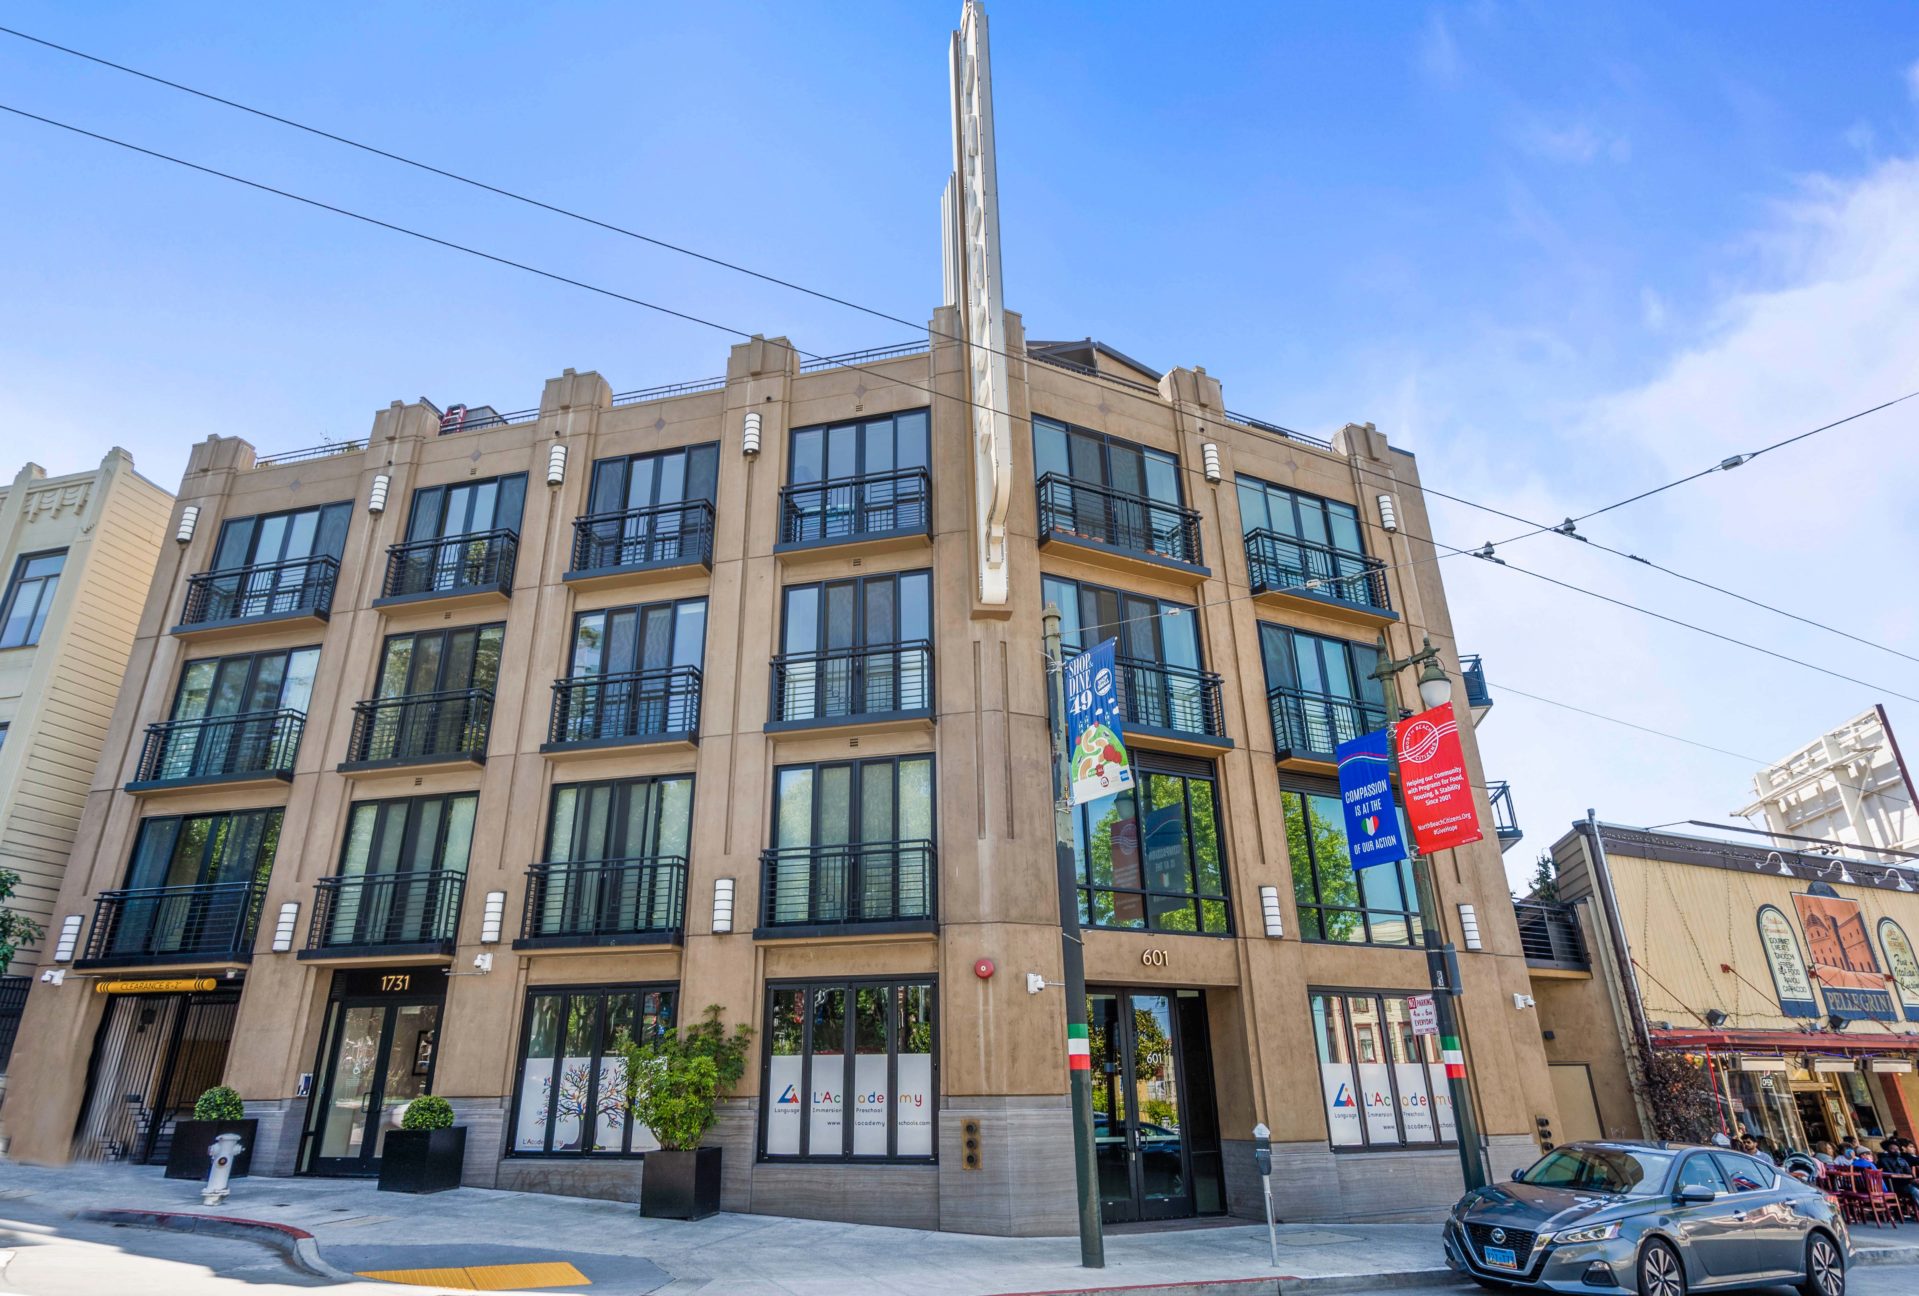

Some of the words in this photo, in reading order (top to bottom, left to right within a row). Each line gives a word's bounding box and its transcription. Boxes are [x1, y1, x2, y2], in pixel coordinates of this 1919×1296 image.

[1069, 653, 1090, 677] SHOP
[1069, 670, 1091, 697] DINE
[1069, 690, 1092, 714] 49
[1415, 724, 1433, 733] BEACH
[1406, 778, 1425, 787] Helping
[1433, 767, 1462, 779] Community
[1344, 779, 1388, 804] COMPASSION
[1407, 787, 1418, 795] with
[1418, 781, 1441, 792] Programs
[1439, 783, 1461, 794] Stability
[1354, 805, 1362, 817] IS
[1362, 802, 1370, 814] AT
[1370, 798, 1382, 812] THE
[1425, 798, 1439, 806] Since
[1439, 794, 1452, 803] 2001
[1353, 844, 1361, 855] OF
[1361, 840, 1375, 853] OUR
[1375, 834, 1397, 850] ACTION
[1142, 949, 1169, 966] 601
[120, 982, 164, 991] CLEARANCE
[381, 975, 410, 991] 1731
[1826, 991, 1894, 1012] PELLEGRINI
[1414, 1018, 1433, 1027] EVERYDAY
[1146, 1053, 1162, 1064] 601
[1334, 1112, 1358, 1120] Language
